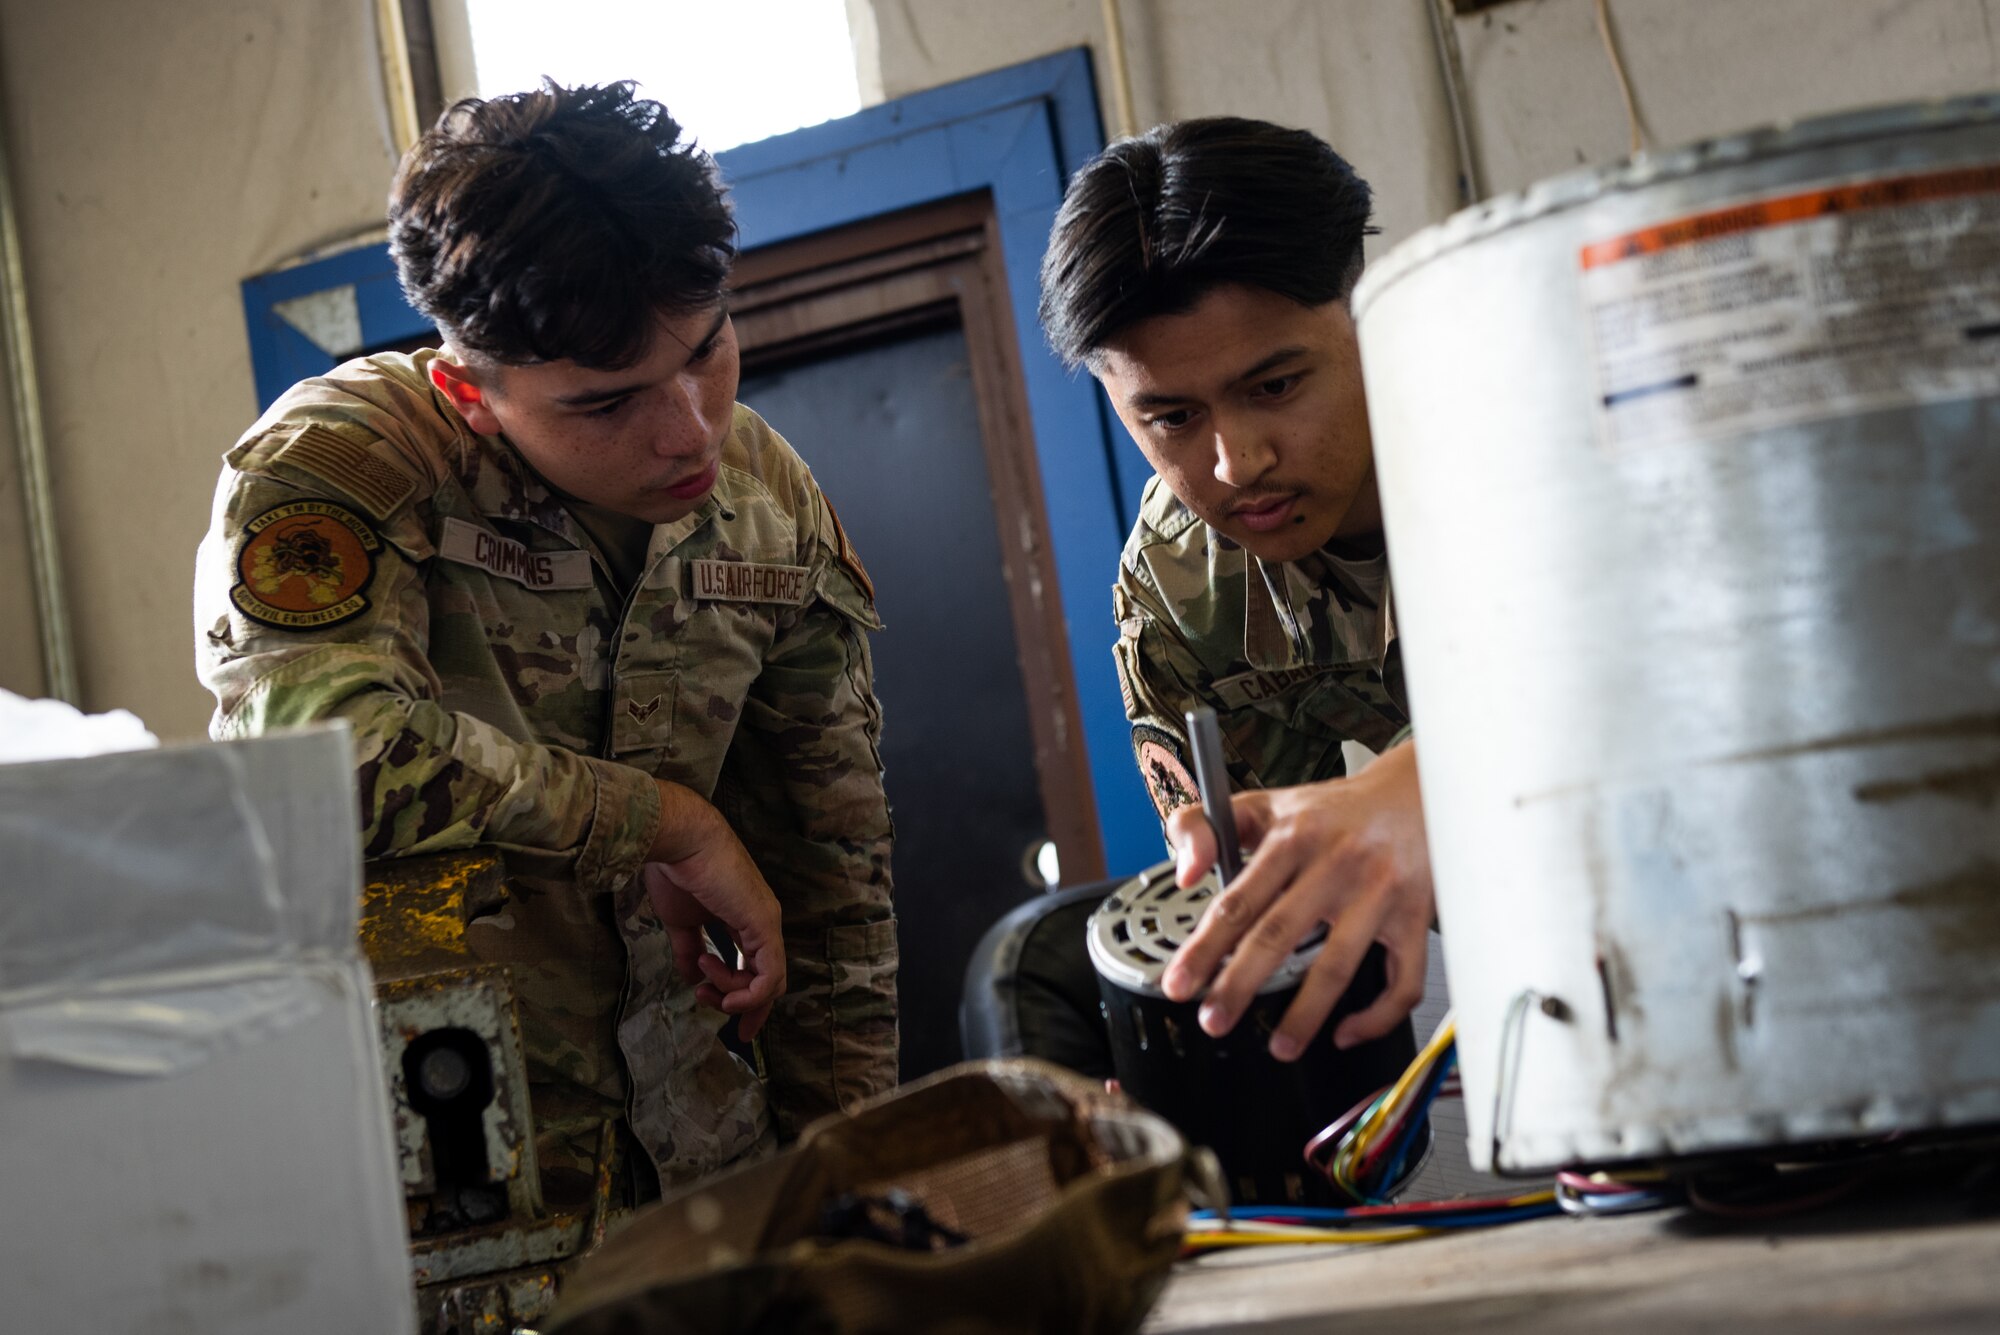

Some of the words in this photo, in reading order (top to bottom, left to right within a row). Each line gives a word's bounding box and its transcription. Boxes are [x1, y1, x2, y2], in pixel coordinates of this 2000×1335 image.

[253, 511, 282, 529] TAKE
[325, 505, 347, 520] THE
[346, 515, 376, 547] HORNS
[726, 566, 752, 597] AIR
[753, 567, 804, 601] FORCE
[253, 603, 280, 622] CIVIL
[284, 607, 345, 625] ENGINEER
